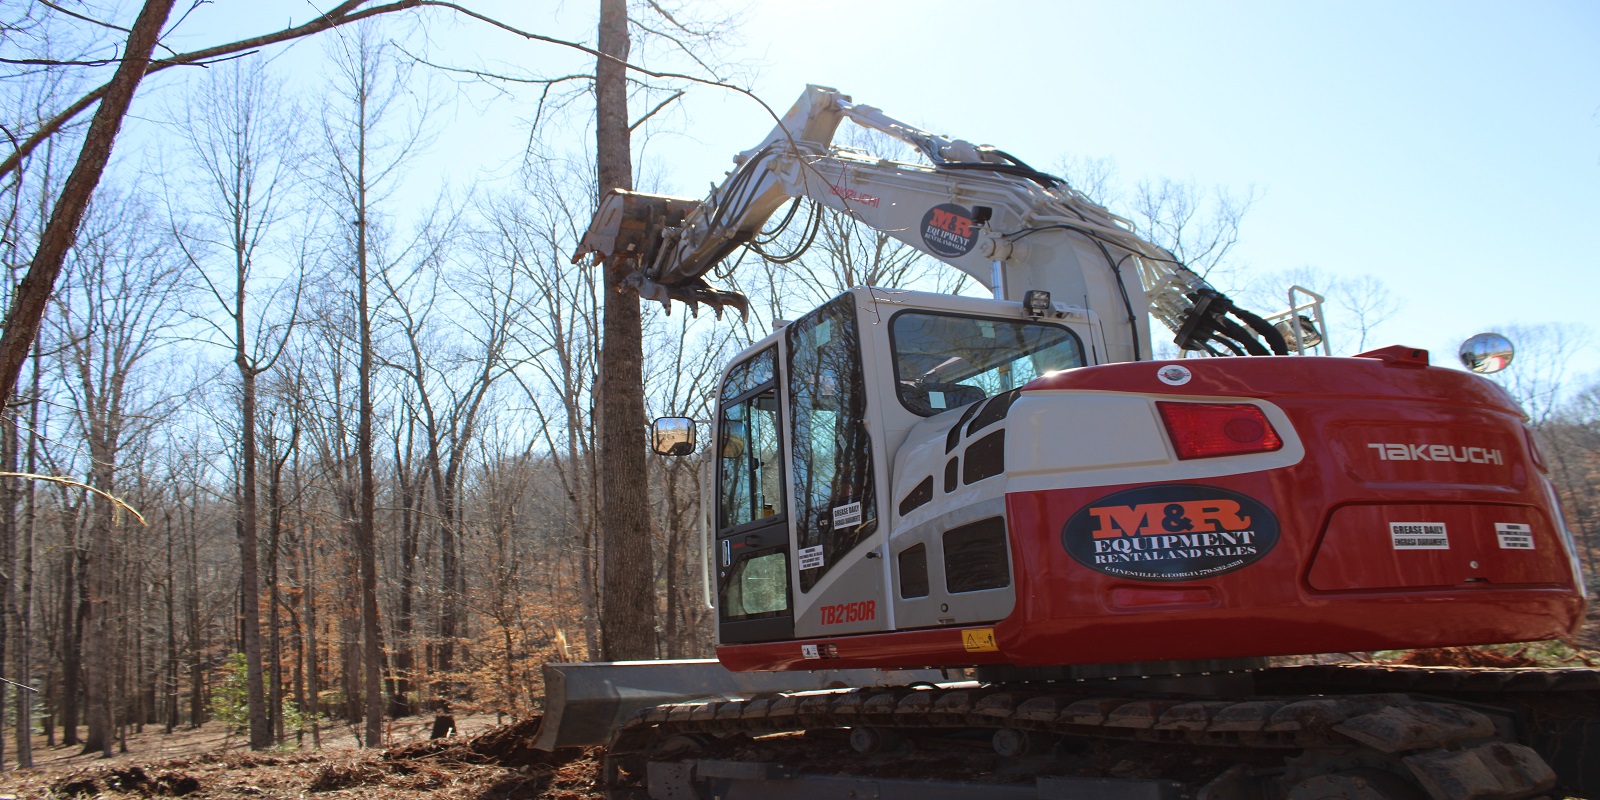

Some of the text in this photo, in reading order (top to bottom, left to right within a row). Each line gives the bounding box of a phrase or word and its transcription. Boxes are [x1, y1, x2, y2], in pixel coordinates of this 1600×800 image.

[929, 207, 973, 238] M&R
[924, 232, 943, 244] RENTAL
[926, 225, 970, 246] EQUIPMENT
[1367, 443, 1504, 466] TAKEUCHI
[1089, 499, 1251, 539] M&R
[1393, 525, 1444, 535] GREASE DAILY
[1092, 531, 1256, 554] EQUIPMENT
[1094, 546, 1257, 564] RENTAL AND SALES
[819, 600, 876, 626] TB2150R
